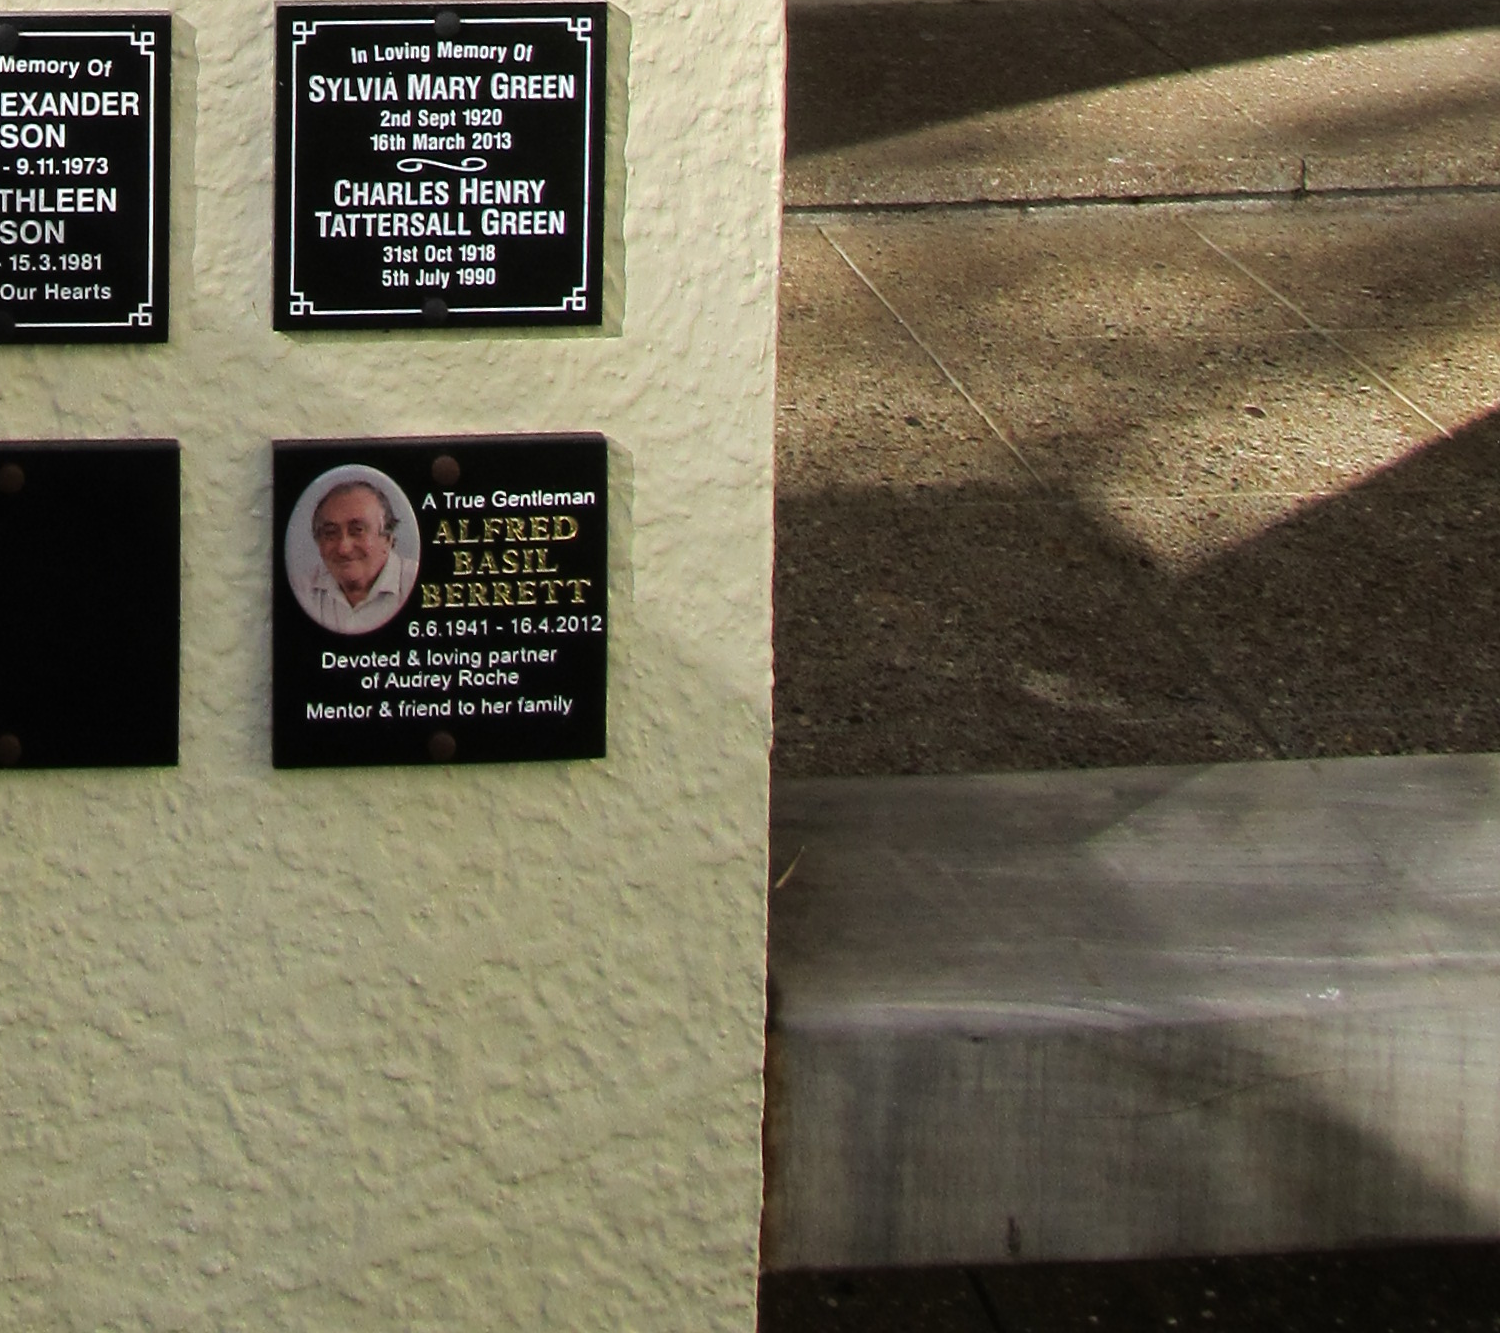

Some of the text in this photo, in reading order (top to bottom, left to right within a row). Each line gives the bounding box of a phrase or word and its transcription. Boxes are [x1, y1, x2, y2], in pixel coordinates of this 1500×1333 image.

[309, 72, 575, 103] SYLVIA MARY GREEN
[380, 108, 503, 130] 2nd Sept 1920
[370, 132, 512, 151] 16th March 2013
[16, 157, 109, 175] 9.11.1973
[334, 178, 545, 207] CHARLES HENRY
[314, 208, 565, 238] TATTERSALL GREEN
[9, 253, 101, 271] 15.3.1981
[422, 490, 595, 510] A True Gentleman
[432, 516, 578, 544] ALFRED
[453, 548, 558, 575] BASIL
[421, 579, 591, 608] BERRETT
[408, 619, 487, 637] 6.6.1941
[511, 615, 602, 634] 16.4.2012
[361, 669, 519, 691] of Audrey Roche
